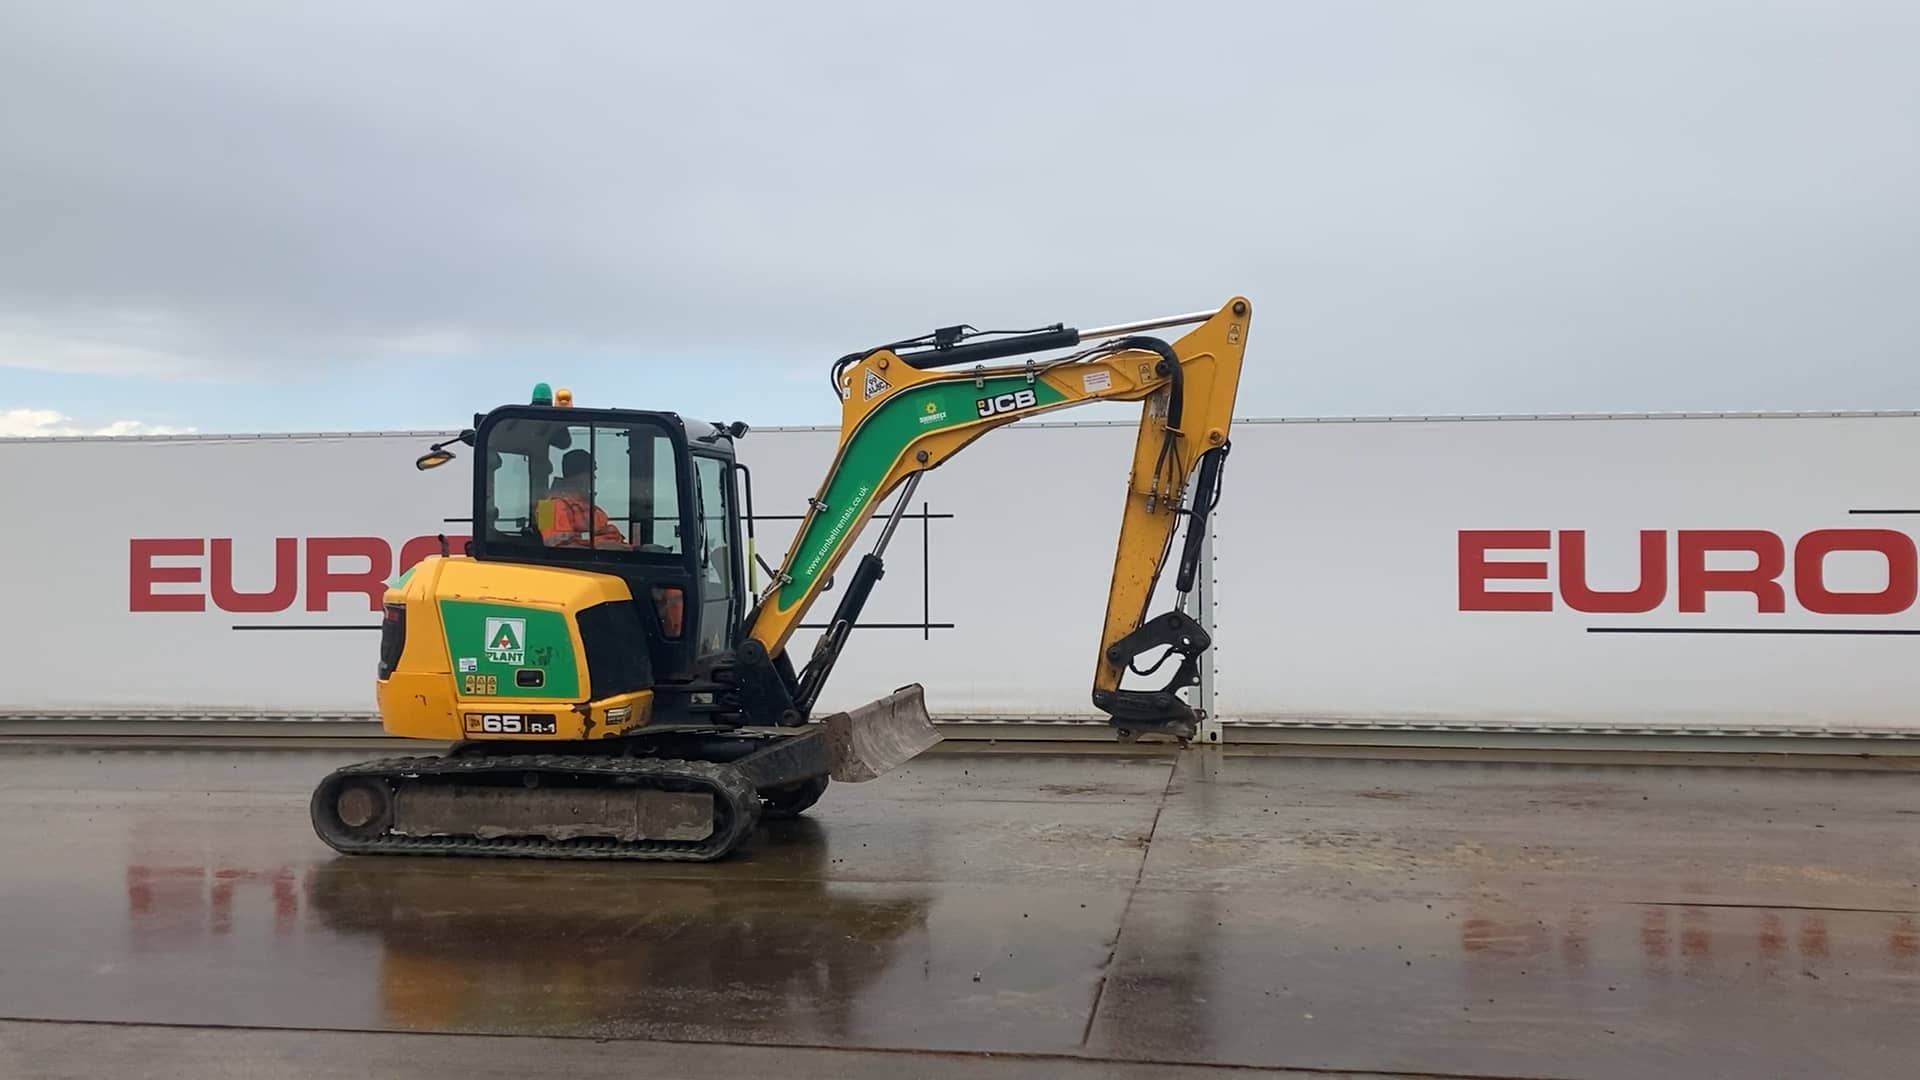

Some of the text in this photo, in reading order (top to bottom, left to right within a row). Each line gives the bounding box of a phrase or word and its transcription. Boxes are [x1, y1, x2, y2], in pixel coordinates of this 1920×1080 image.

[980, 390, 1036, 417] JCB
[806, 486, 869, 575] www.sunbeltrentals.co.uk
[1458, 528, 1918, 615] EURO
[483, 714, 521, 732] 65
[531, 723, 555, 732] R-1
